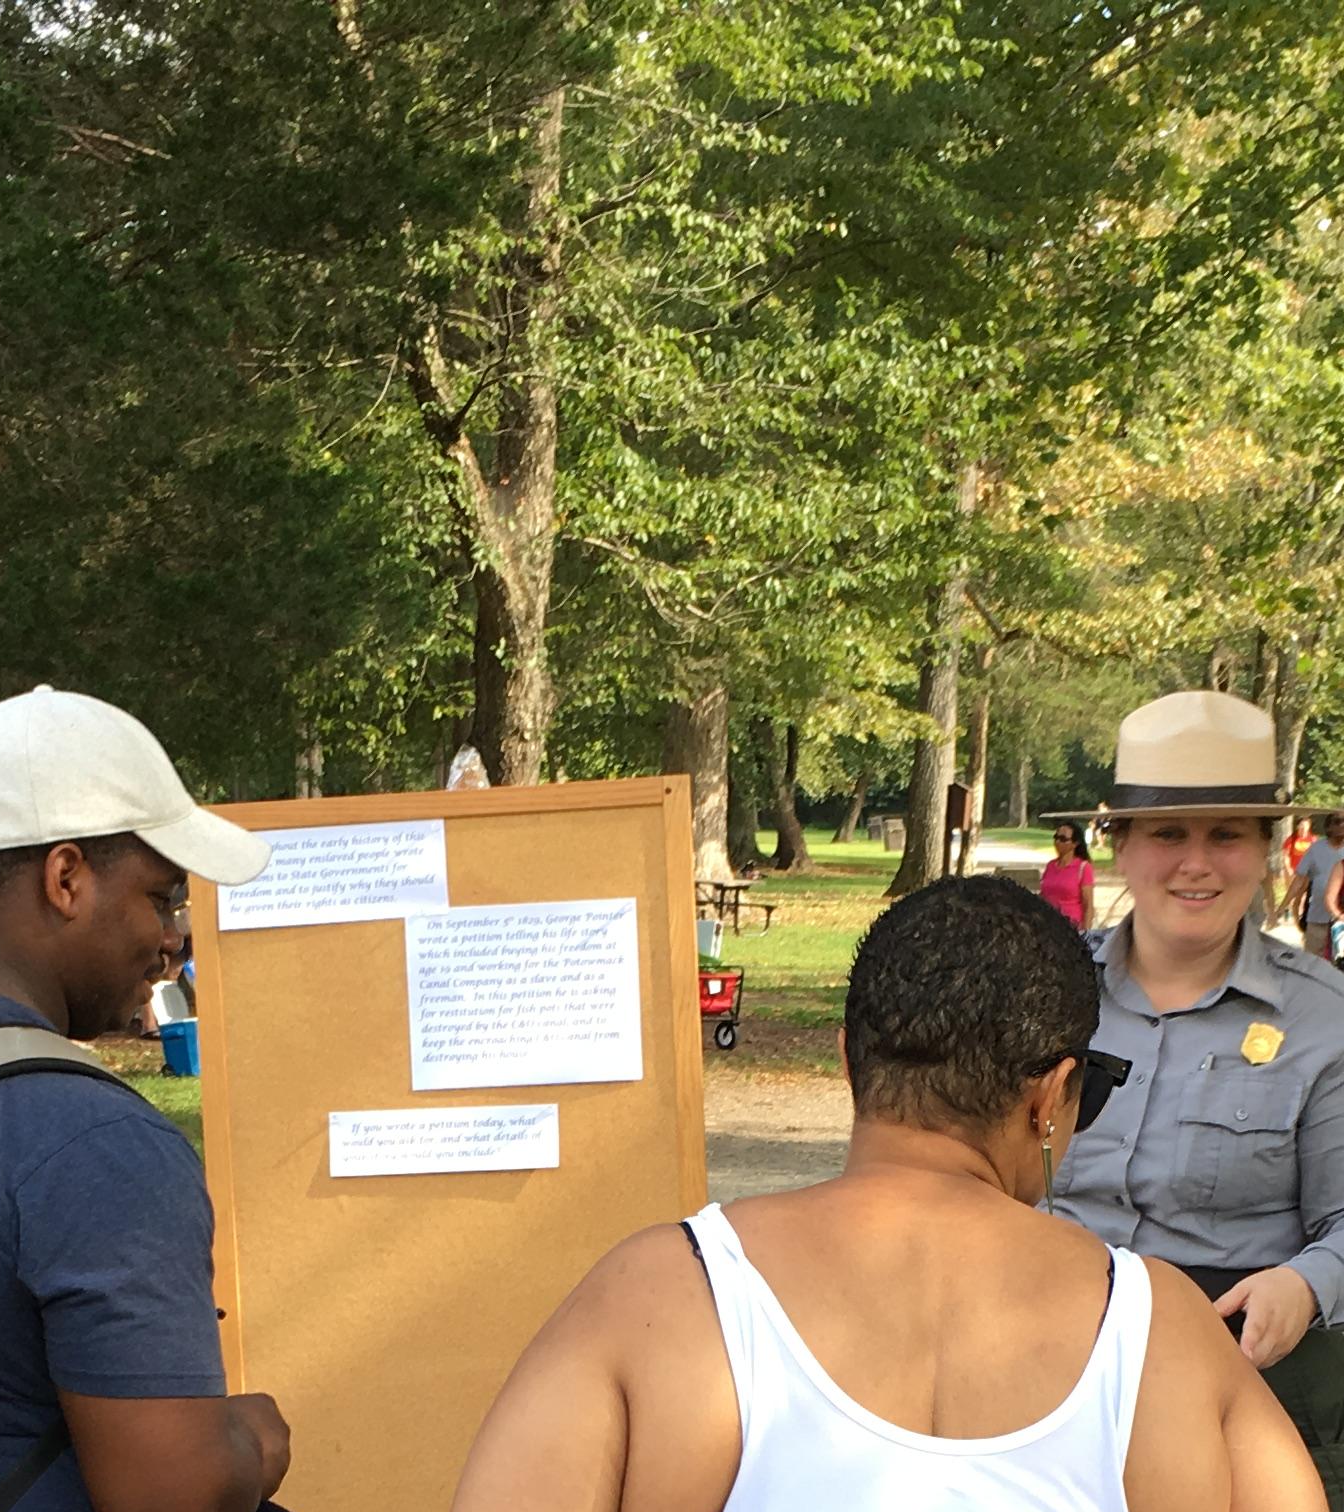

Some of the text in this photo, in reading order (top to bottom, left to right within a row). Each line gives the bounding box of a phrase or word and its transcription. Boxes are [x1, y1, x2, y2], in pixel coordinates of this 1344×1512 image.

[302, 838, 317, 849] the
[321, 837, 348, 850] early
[351, 834, 388, 846] history
[392, 832, 403, 845] of
[275, 847, 424, 868] many enslaved people wrote
[277, 872, 288, 881] to
[291, 869, 317, 880] State
[392, 862, 408, 875] for
[229, 874, 435, 901] freedom and to justify why they should
[277, 899, 302, 910] their
[305, 896, 337, 911] rights
[427, 920, 443, 930] On
[445, 917, 500, 932] September
[545, 913, 582, 927] George
[417, 934, 448, 945] wrote
[451, 934, 458, 944] a
[460, 931, 503, 946] petition
[505, 929, 540, 943] telling
[542, 928, 557, 938] his
[560, 927, 577, 941] life
[418, 947, 450, 960] which
[453, 944, 499, 958] included
[501, 944, 538, 958] buying
[558, 940, 602, 956] freedom
[418, 966, 436, 977] age
[453, 962, 474, 973] and
[477, 959, 521, 972] working
[523, 959, 540, 972] for
[543, 958, 558, 968] the
[419, 977, 451, 990] Canal
[453, 975, 503, 989] Company
[505, 976, 517, 985] as
[520, 976, 527, 984] a
[559, 971, 581, 983] and
[598, 972, 605, 980] a
[473, 992, 484, 1002] In
[489, 990, 507, 1001] this
[419, 1008, 436, 1022] for
[497, 1004, 514, 1019] for
[564, 1002, 586, 1012] that
[421, 1019, 472, 1034] destroyed
[475, 1019, 489, 1033] by
[492, 1019, 508, 1031] the
[422, 1038, 446, 1050] keep
[448, 1035, 465, 1047] the
[422, 1051, 478, 1064] destroying
[363, 1123, 382, 1135] you
[386, 1122, 416, 1132] wrote
[419, 1121, 426, 1130] a
[509, 1114, 536, 1127] what
[376, 1137, 395, 1148] you
[440, 1133, 461, 1144] and
[463, 1131, 490, 1143] what
